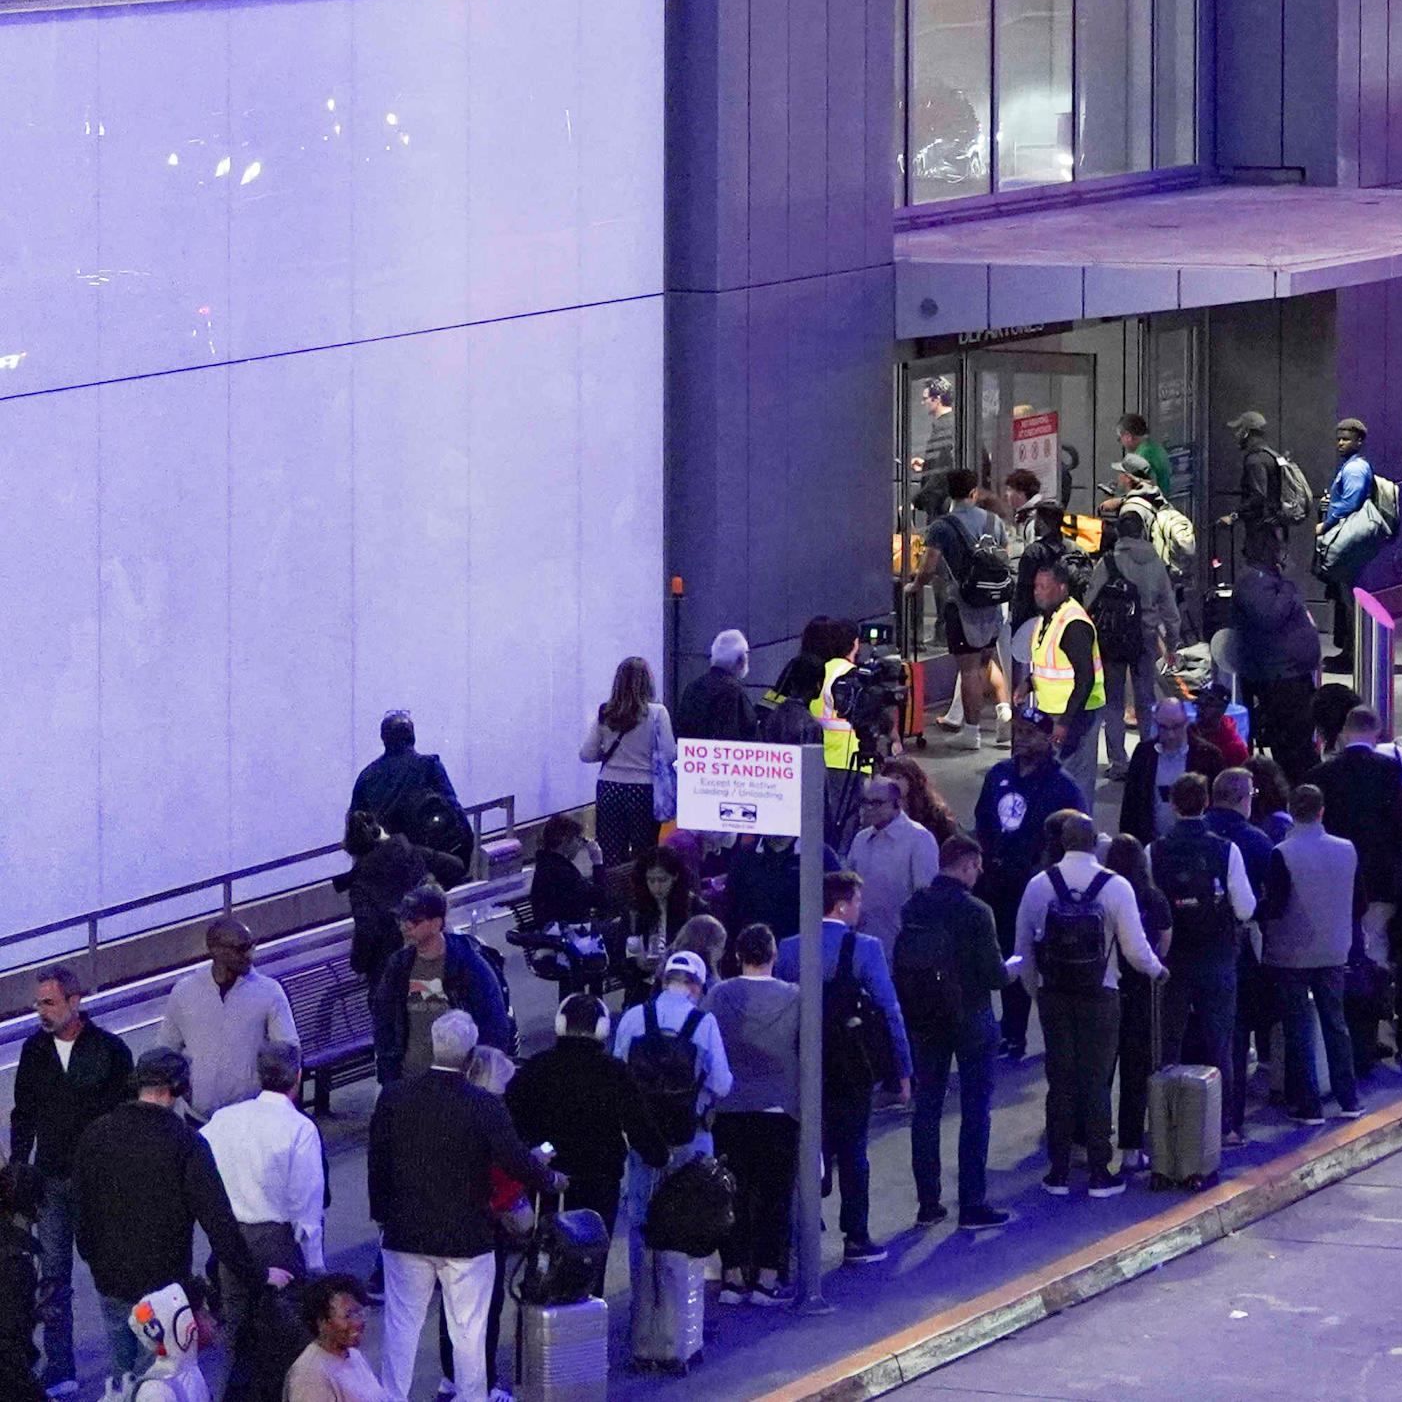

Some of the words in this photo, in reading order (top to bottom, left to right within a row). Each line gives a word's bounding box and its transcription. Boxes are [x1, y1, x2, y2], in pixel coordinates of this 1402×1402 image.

[684, 745, 708, 759] NO
[713, 747, 793, 764] STOPPING
[684, 761, 706, 773] OR
[711, 762, 794, 779] STANDING
[700, 778, 730, 789] Except
[733, 779, 745, 788] for
[693, 787, 729, 797] Loading
[738, 789, 784, 800] Unloading
